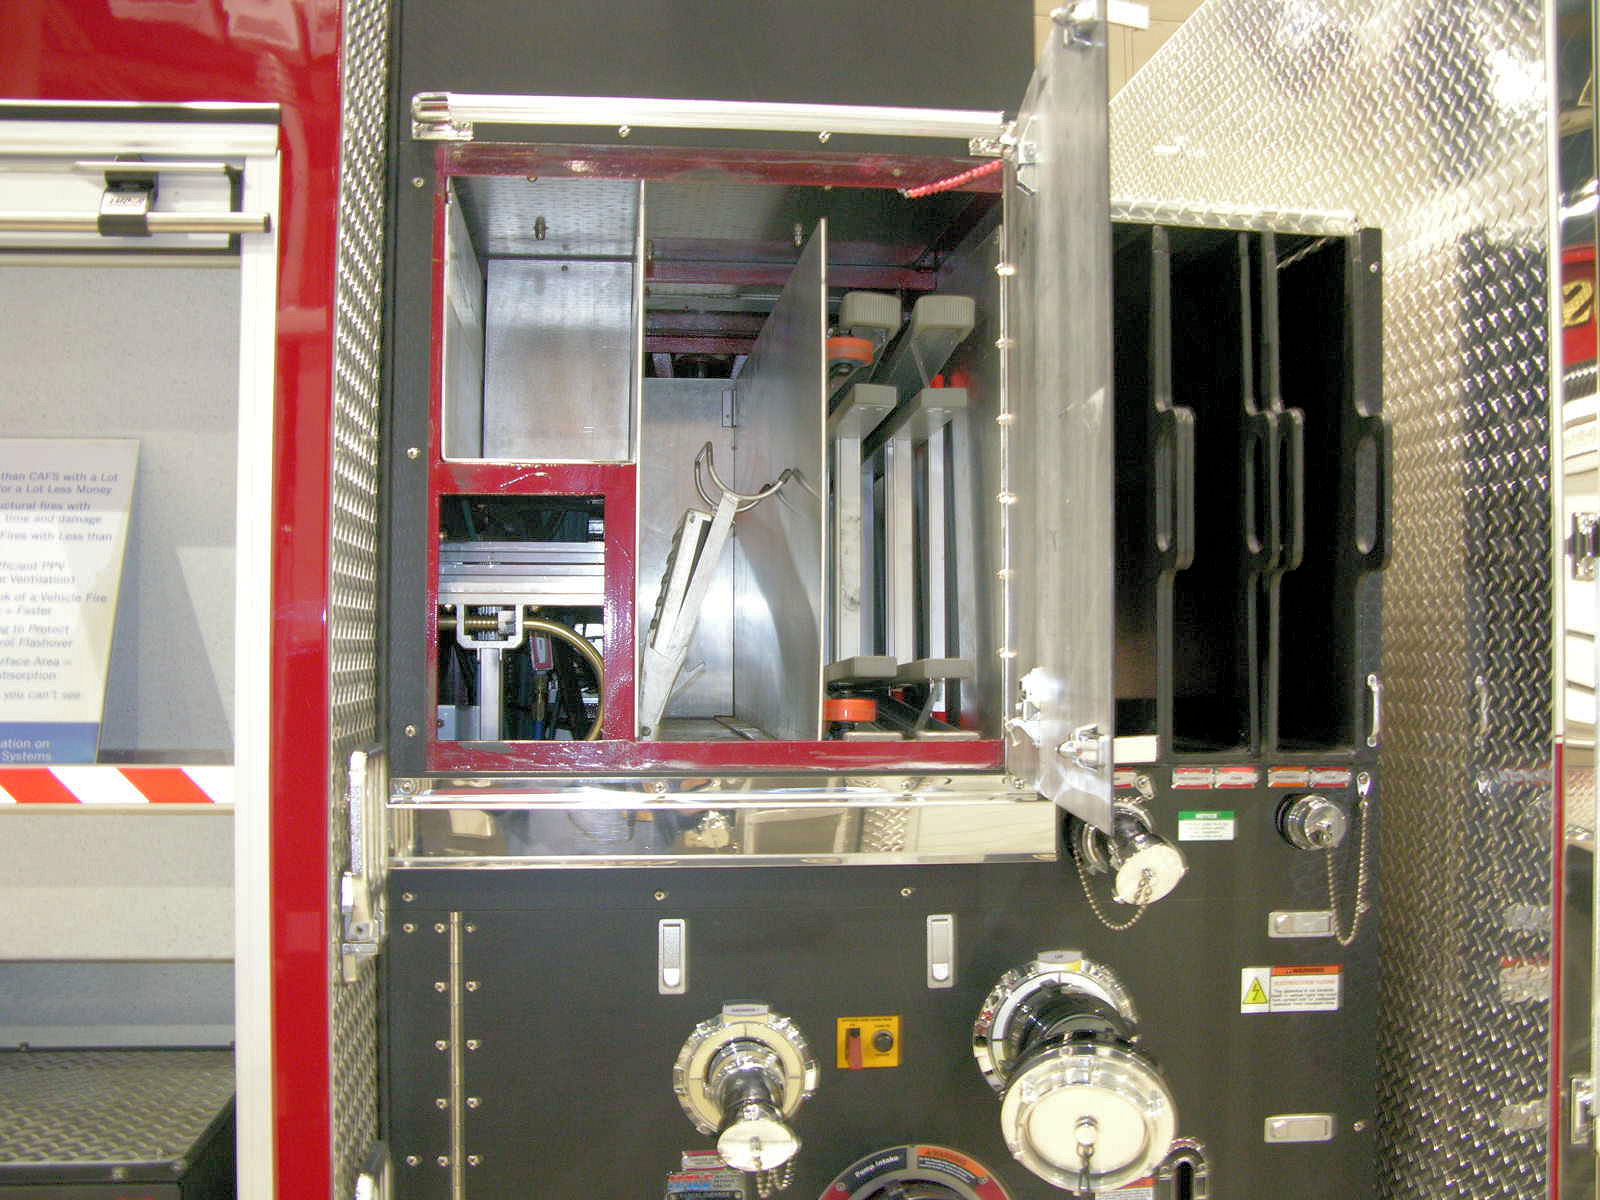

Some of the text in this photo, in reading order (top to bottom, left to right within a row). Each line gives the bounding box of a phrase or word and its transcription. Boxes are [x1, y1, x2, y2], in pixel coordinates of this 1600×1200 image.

[0, 471, 25, 481] than
[63, 471, 87, 481] with
[101, 471, 119, 481] Lot
[26, 484, 45, 494] Lot
[47, 485, 72, 495] Less
[76, 484, 112, 496] Money
[66, 501, 91, 510] with
[58, 513, 102, 526] damage
[85, 591, 108, 603] Fire
[18, 638, 73, 649] Flashover
[35, 740, 51, 749] on
[2, 750, 52, 762] Systems
